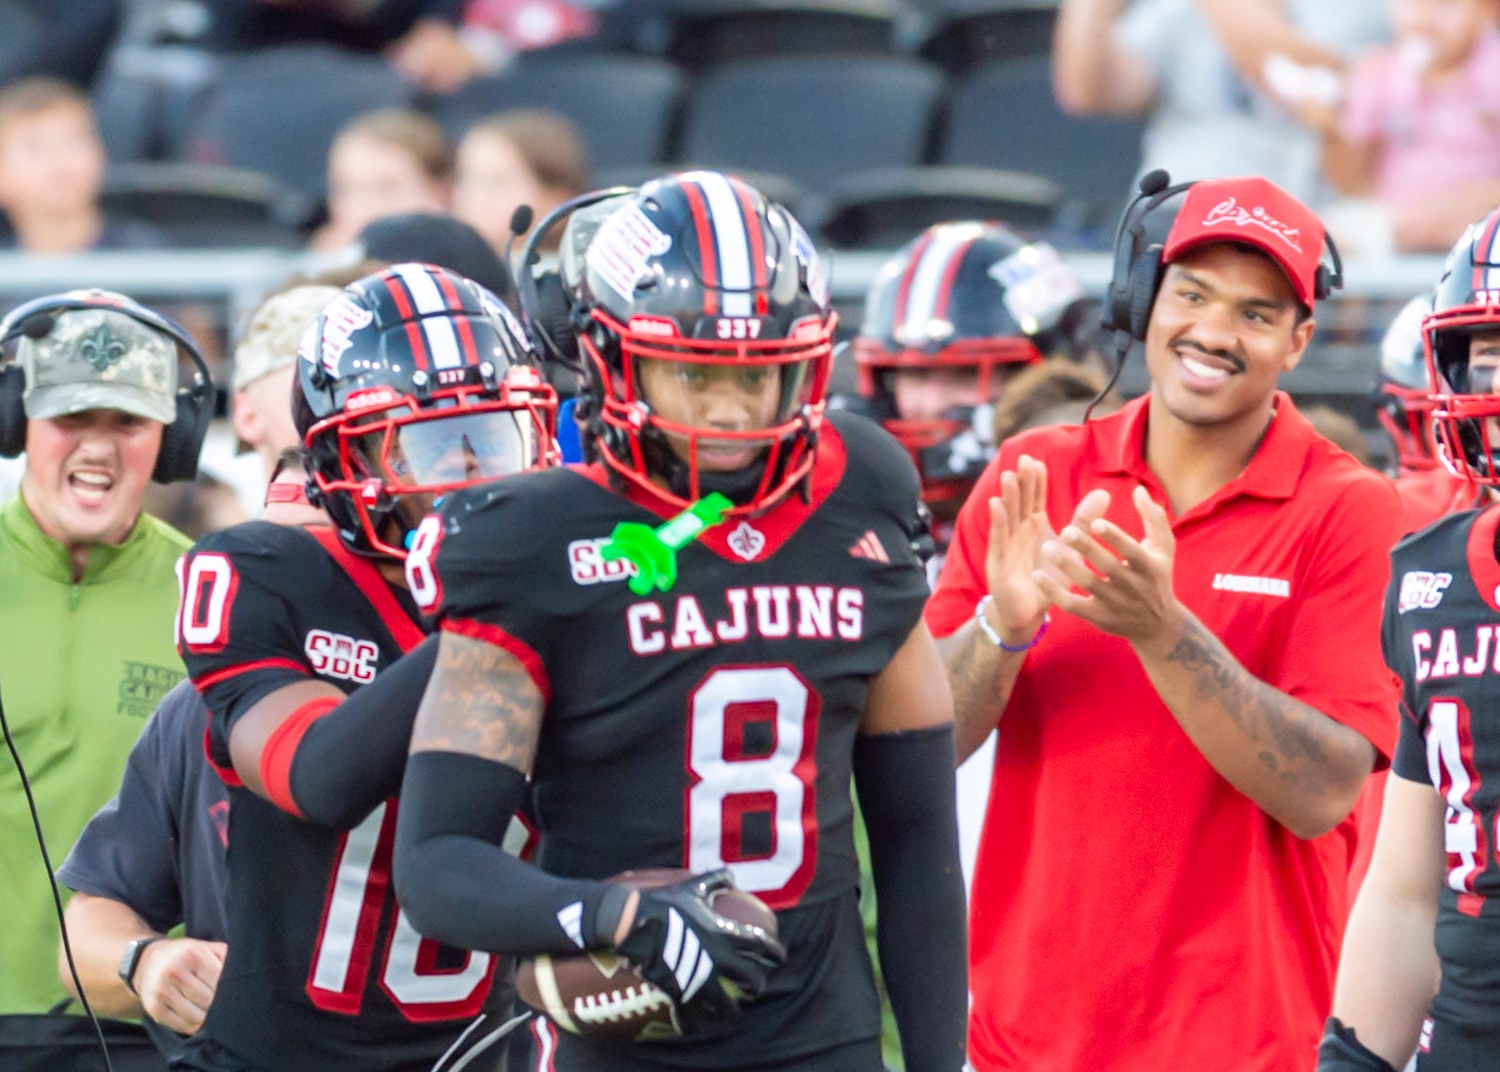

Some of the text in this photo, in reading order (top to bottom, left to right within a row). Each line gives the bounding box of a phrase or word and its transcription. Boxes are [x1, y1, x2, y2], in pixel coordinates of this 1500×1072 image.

[716, 318, 762, 340] 337
[437, 371, 465, 385] 337
[405, 513, 445, 616] 8
[568, 537, 639, 585] SB
[626, 585, 864, 657] CAJUNS
[304, 629, 379, 684] SBC
[1412, 622, 1500, 682] CAJ
[684, 662, 822, 910] 8
